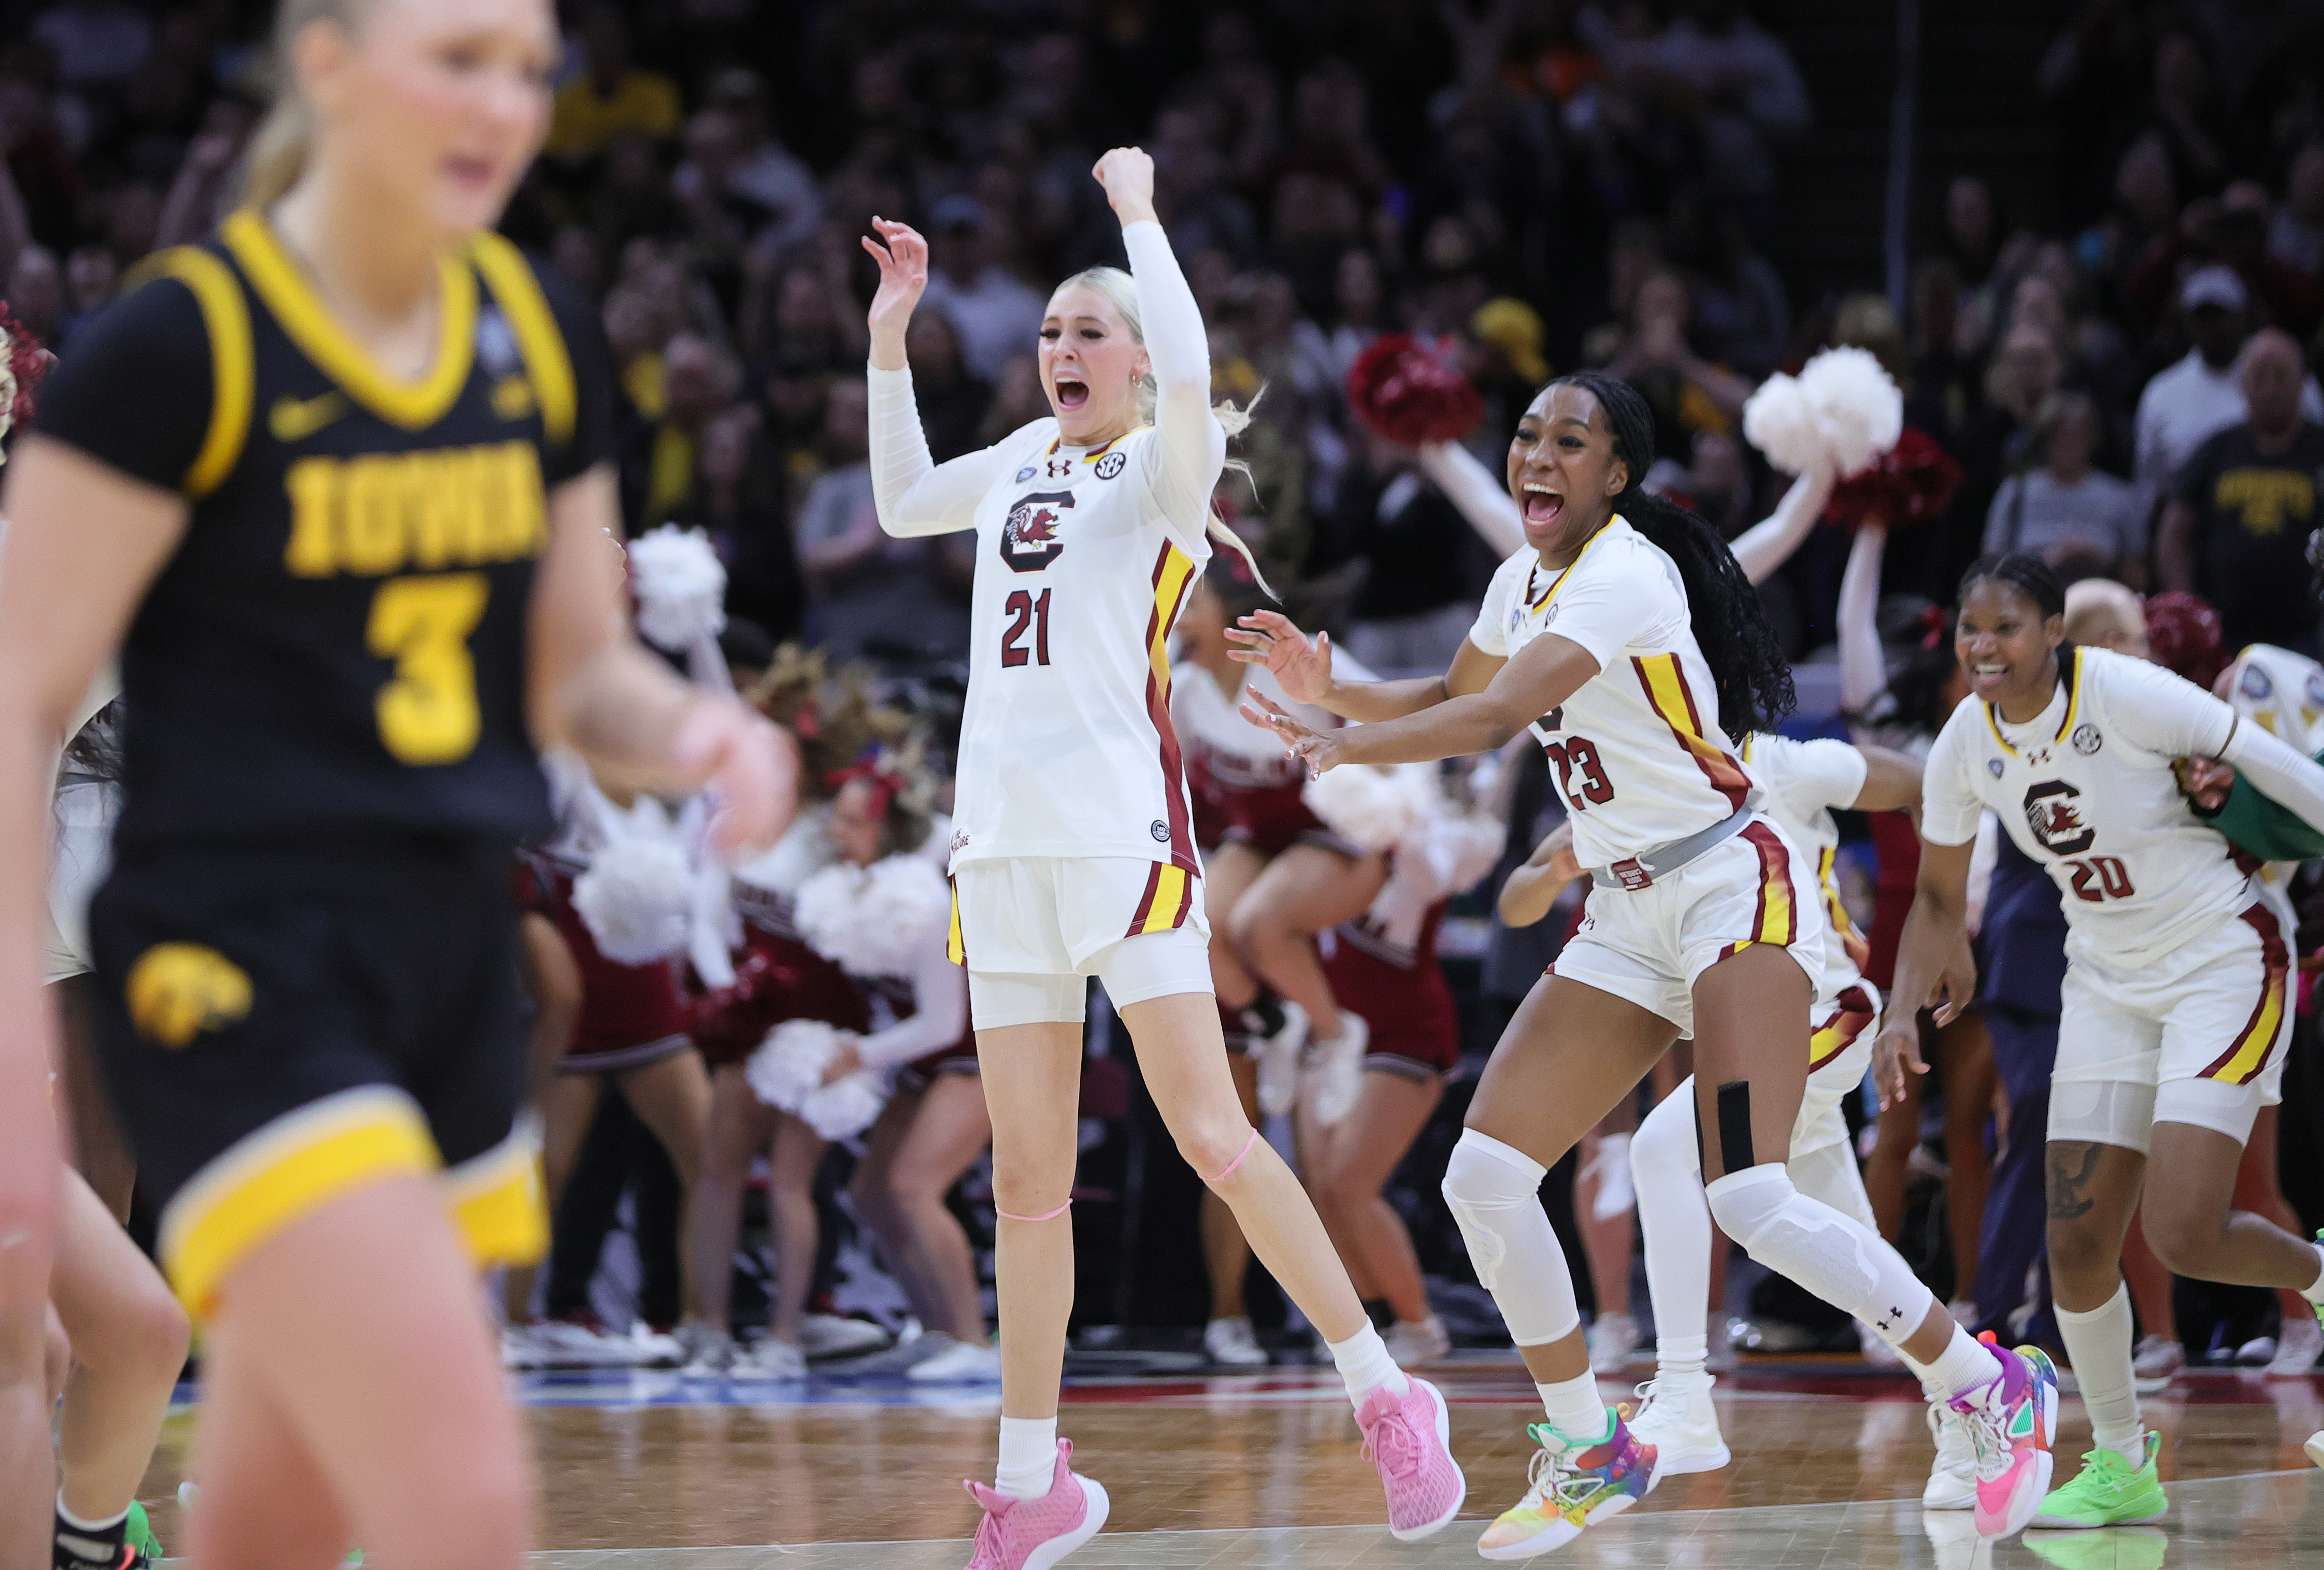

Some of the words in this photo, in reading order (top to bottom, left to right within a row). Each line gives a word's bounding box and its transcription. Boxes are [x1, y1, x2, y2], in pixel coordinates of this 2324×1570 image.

[1097, 453, 1124, 477] SEC
[1002, 588, 1051, 668] 21
[366, 574, 490, 766] 3
[1544, 736, 1615, 810] 23
[2063, 858, 2134, 901] 20
